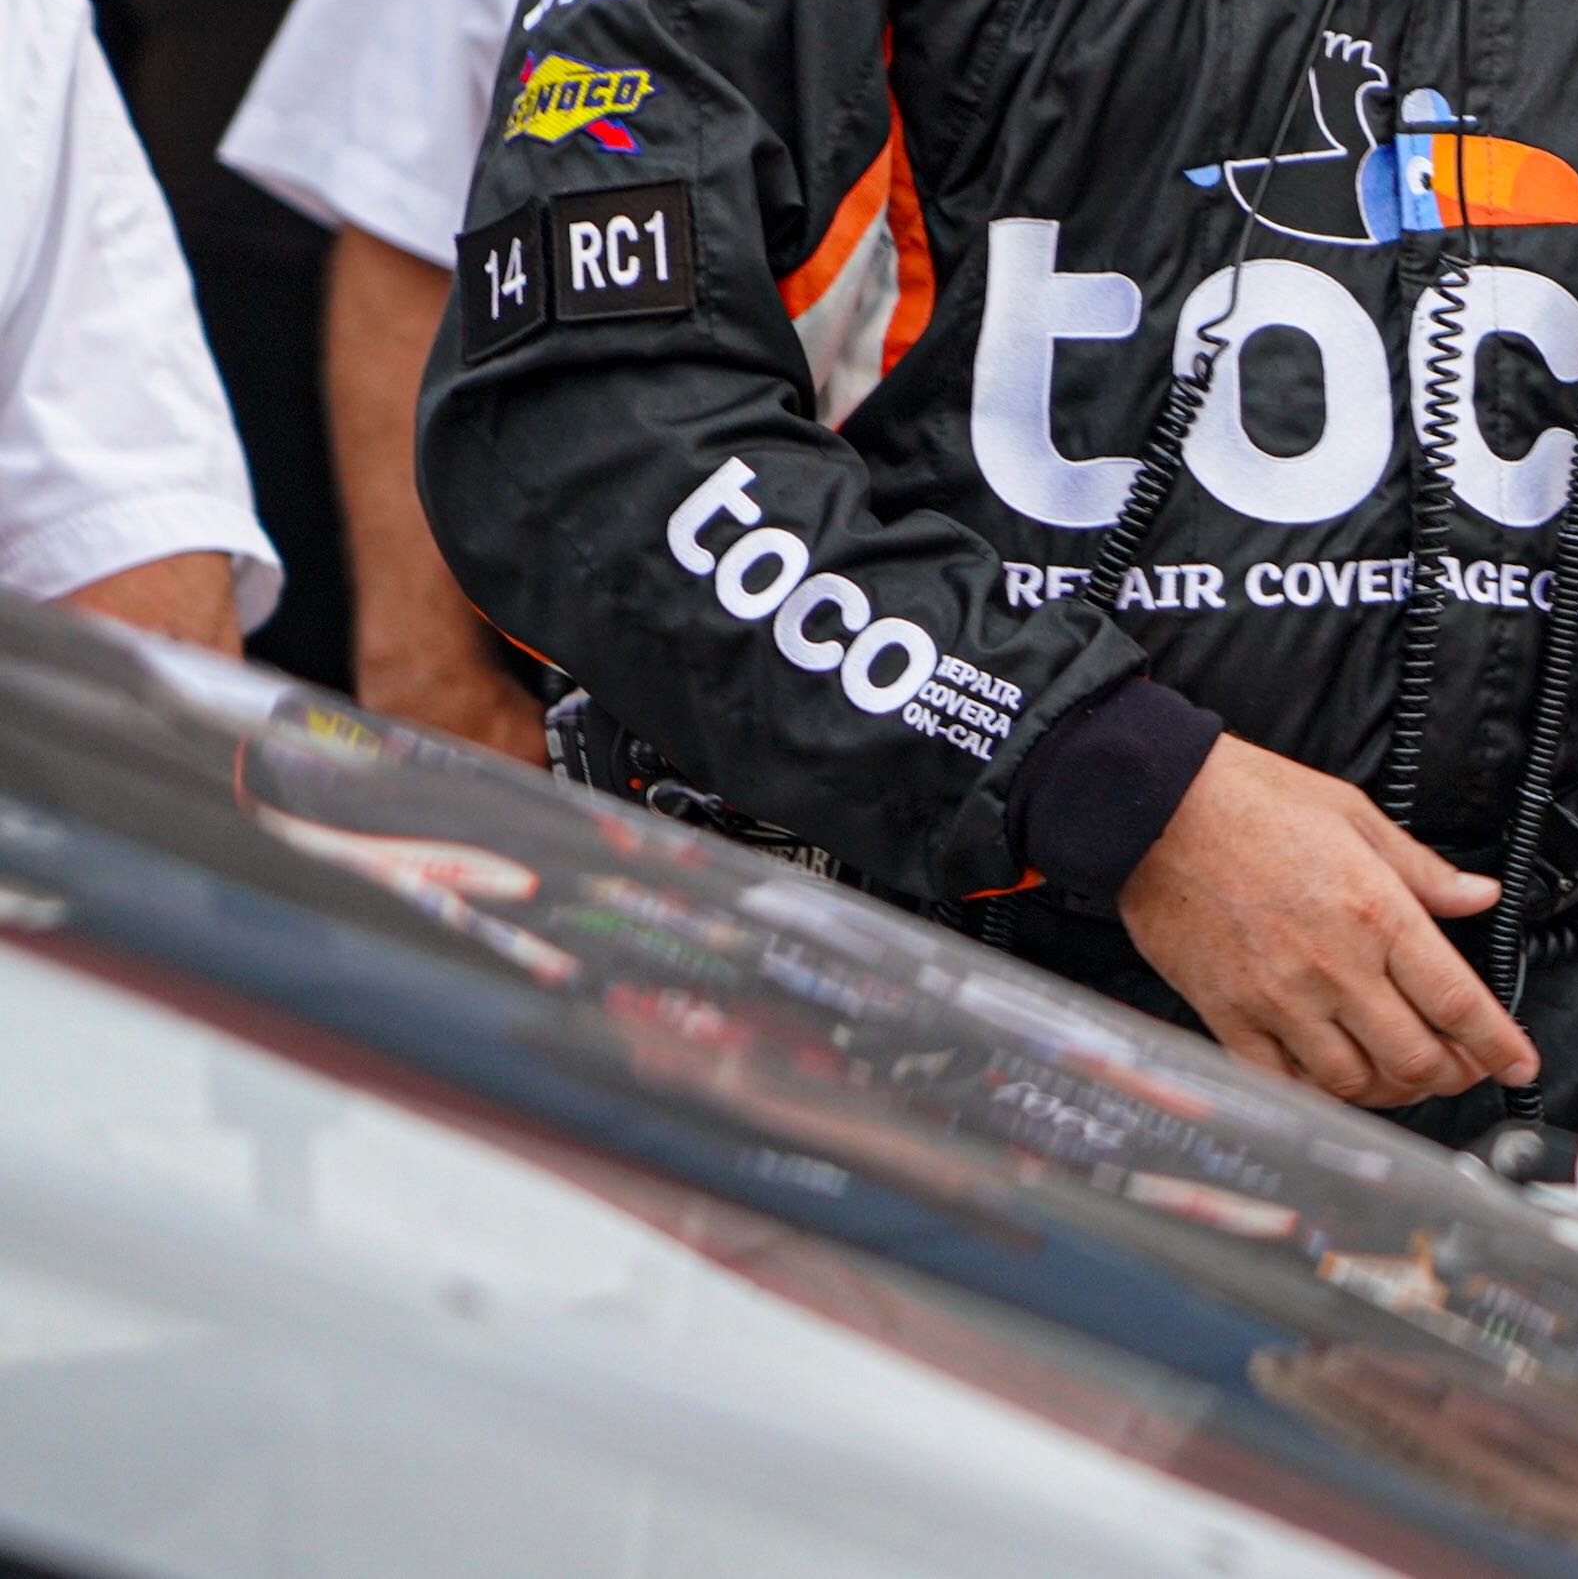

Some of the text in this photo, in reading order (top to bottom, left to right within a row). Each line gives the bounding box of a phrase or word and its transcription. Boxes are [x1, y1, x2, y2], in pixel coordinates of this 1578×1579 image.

[484, 209, 669, 321] 14 RC1
[666, 456, 938, 715] toco
[1001, 560, 1227, 610] REAIR
[901, 701, 994, 761] ON-CAL
[919, 680, 1012, 739] COVERA
